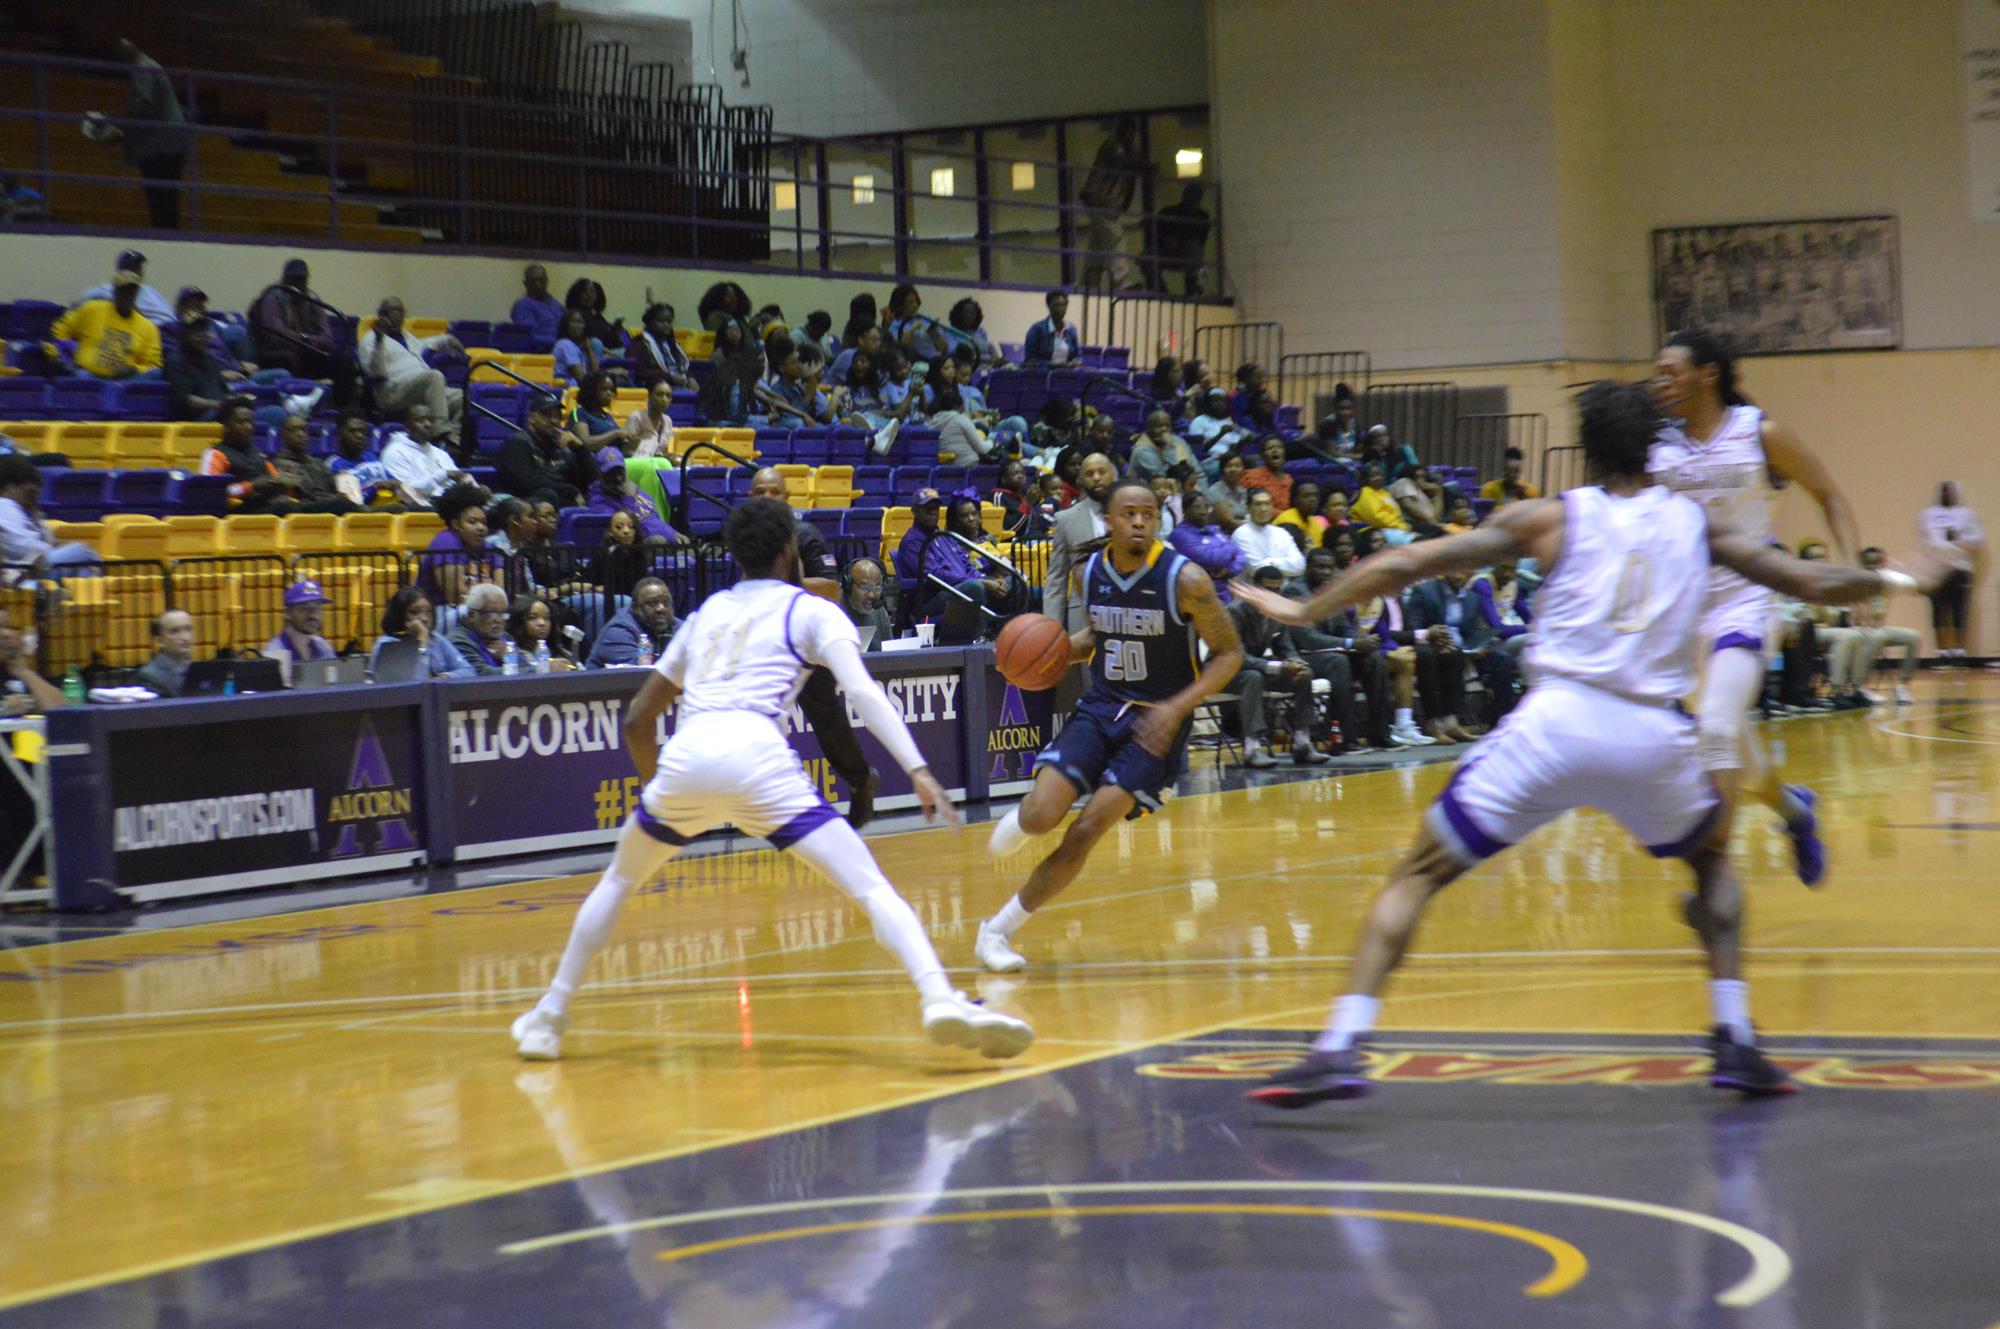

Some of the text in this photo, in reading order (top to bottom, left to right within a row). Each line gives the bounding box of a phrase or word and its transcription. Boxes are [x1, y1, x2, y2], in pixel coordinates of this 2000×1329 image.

[1089, 604, 1166, 636] SOUTHERN
[1104, 638, 1148, 682] 20
[447, 699, 621, 764] ALCORN
[987, 725, 1041, 752] ALCORN
[114, 788, 315, 852] ALCORNSPORTS.COM
[328, 788, 412, 822] ALCORN
